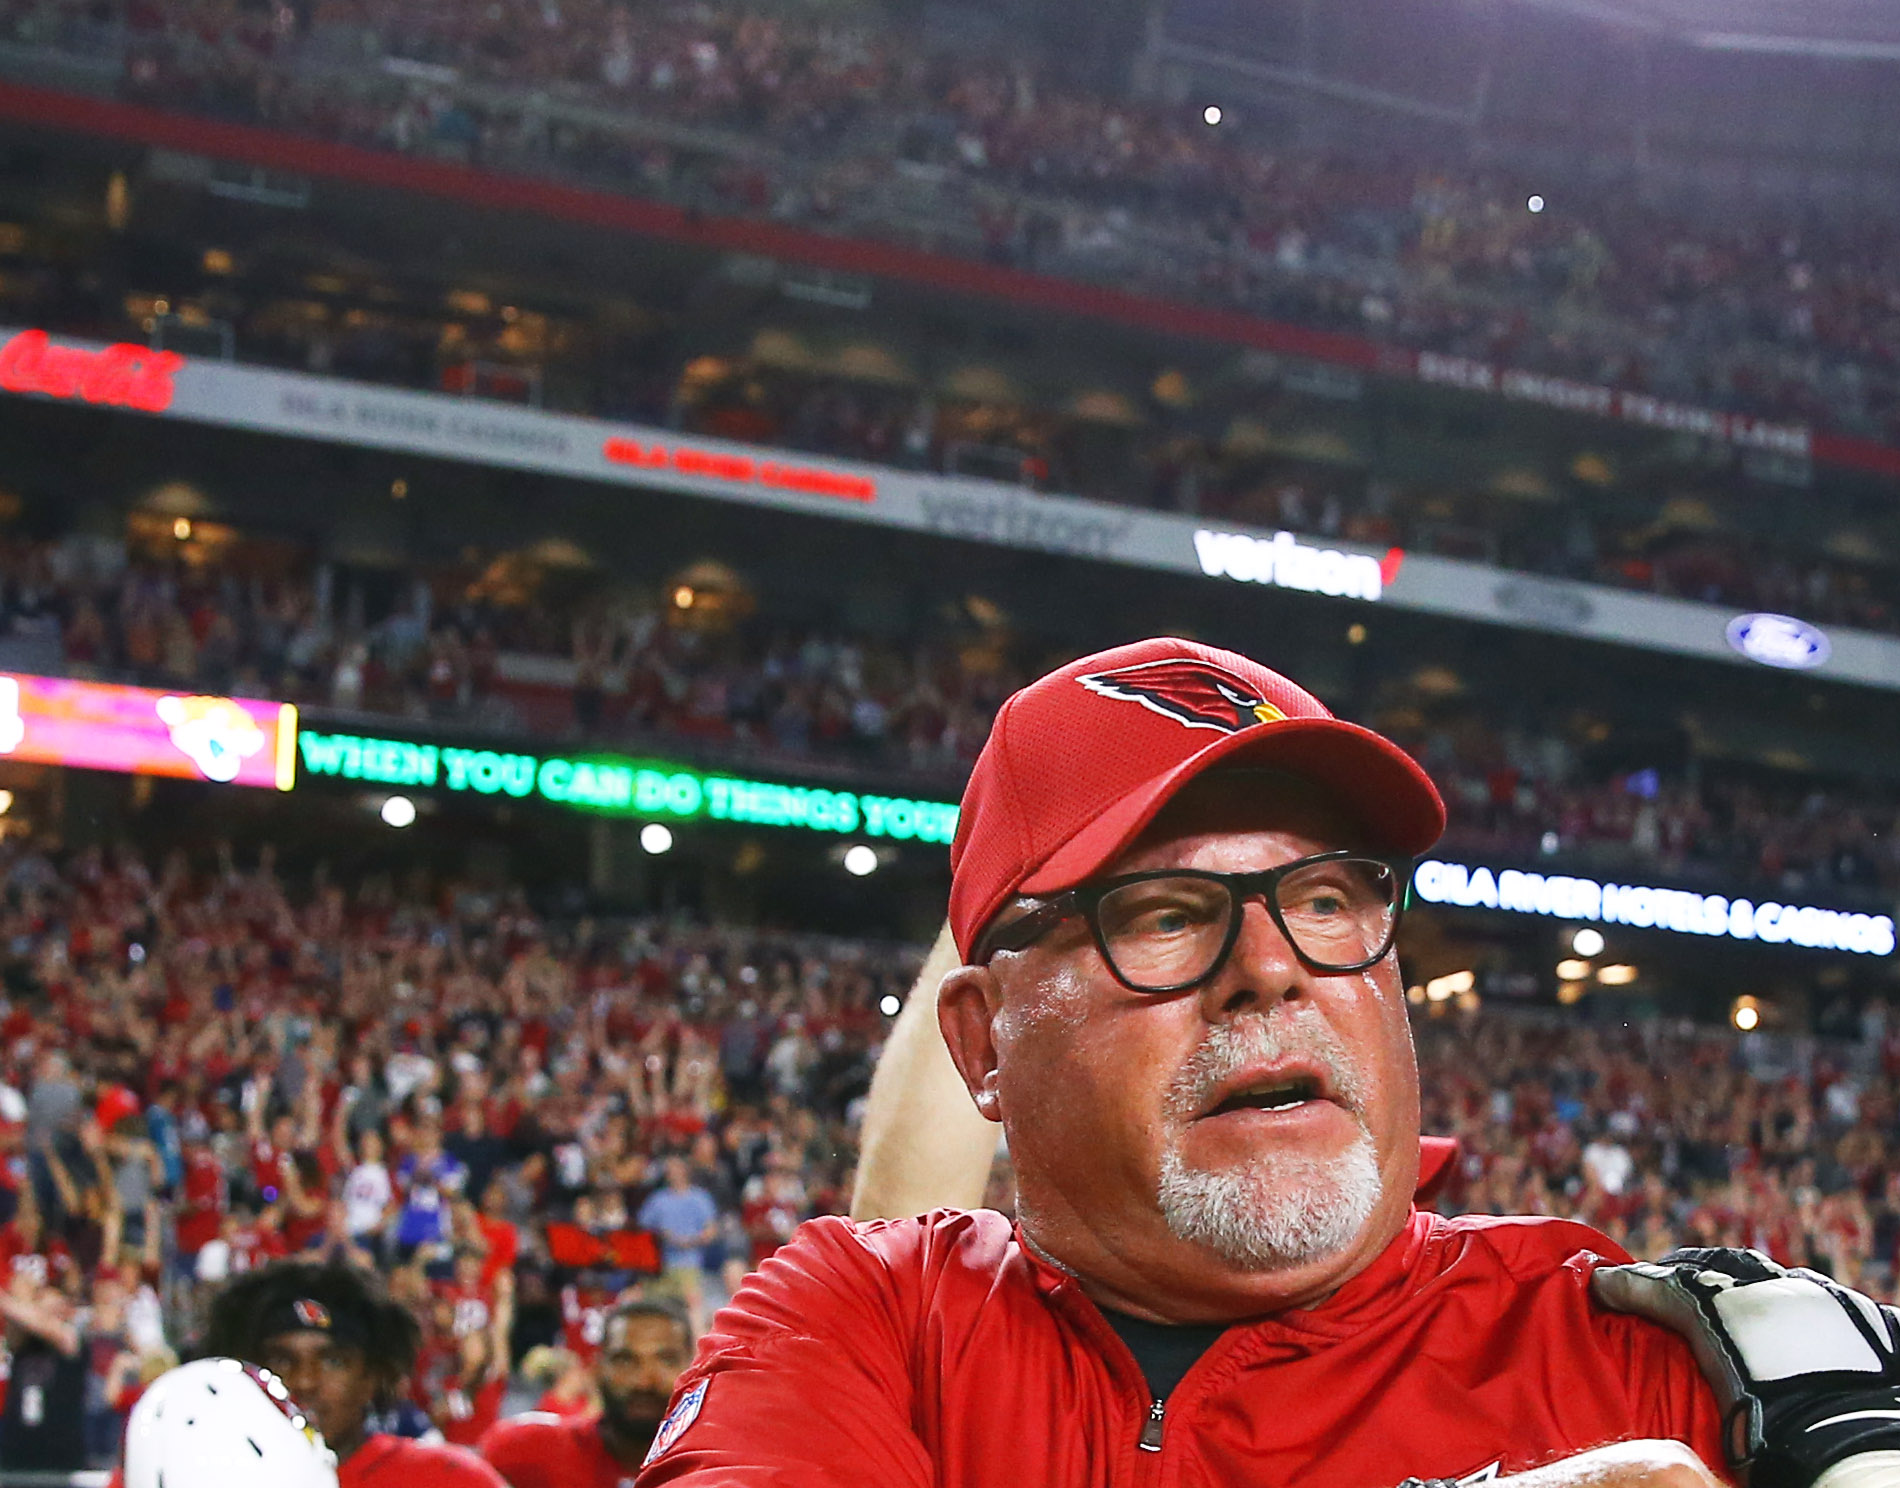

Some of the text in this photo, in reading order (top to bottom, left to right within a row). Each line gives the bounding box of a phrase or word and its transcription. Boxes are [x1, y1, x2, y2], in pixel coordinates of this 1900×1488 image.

[1193, 530, 1382, 601] verizon
[298, 730, 440, 787] WHEN
[440, 747, 538, 798] YOU
[537, 758, 634, 808] CAN
[634, 769, 702, 815] DO
[703, 777, 859, 834] THINGS
[1499, 869, 1601, 922] RIVER
[1601, 882, 1729, 937] HOTELS
